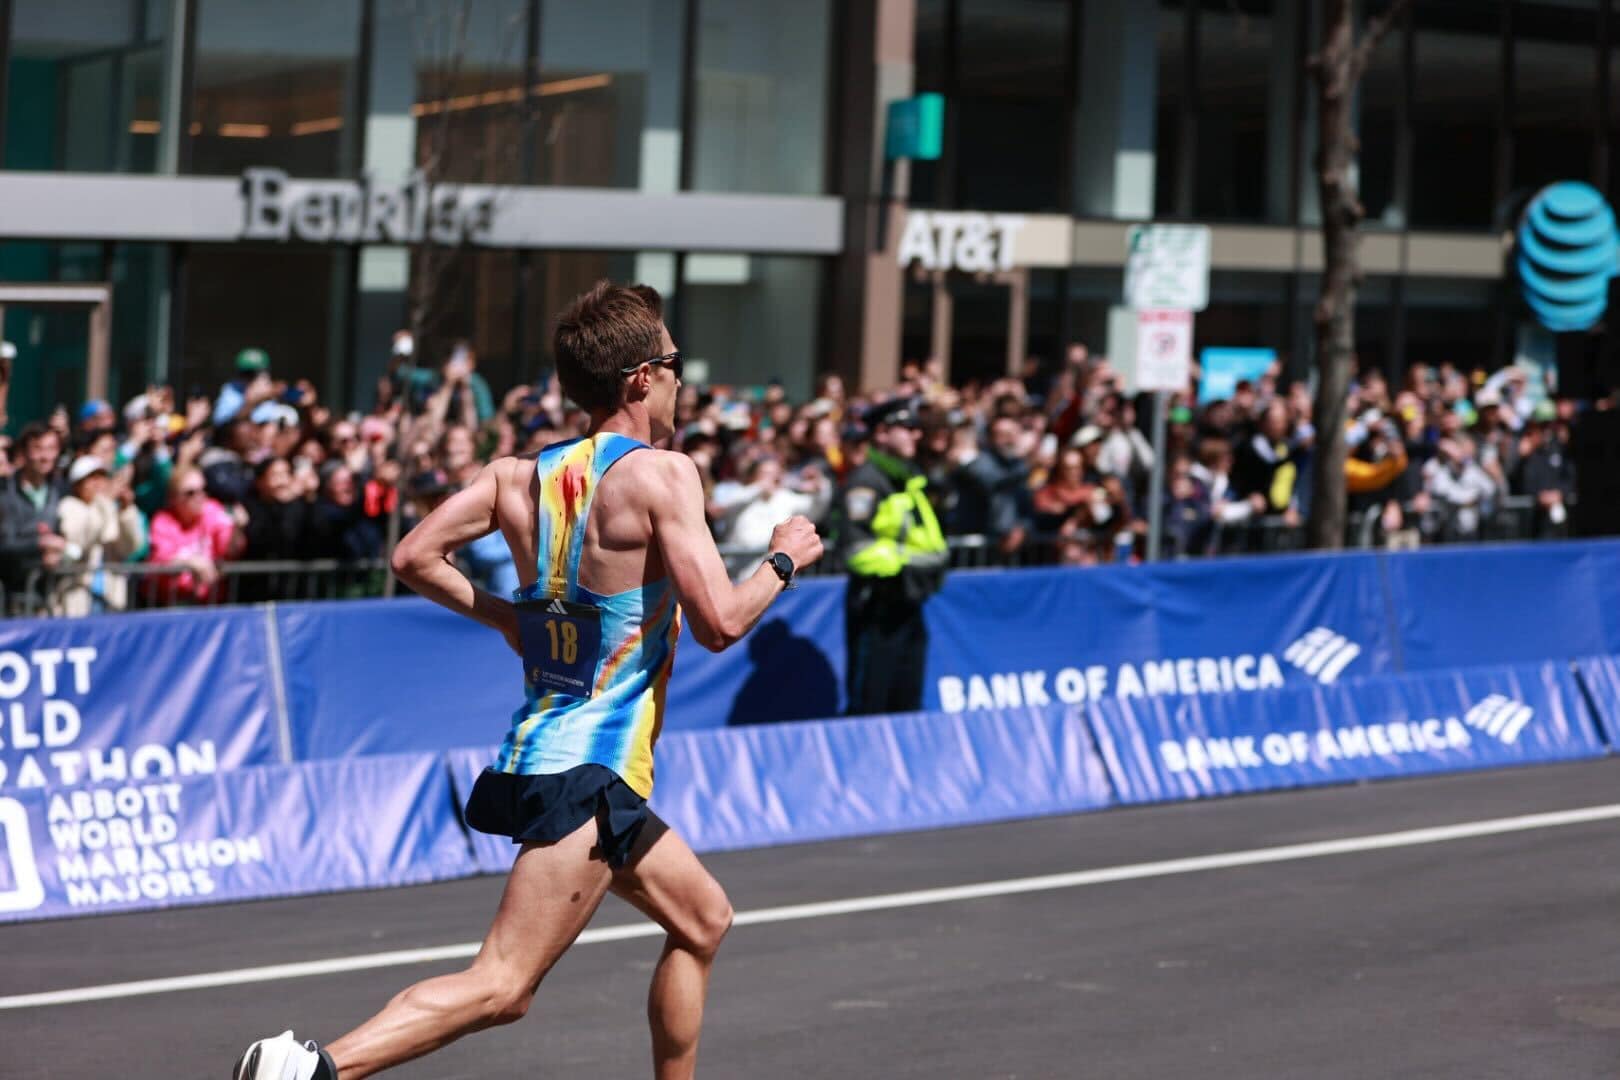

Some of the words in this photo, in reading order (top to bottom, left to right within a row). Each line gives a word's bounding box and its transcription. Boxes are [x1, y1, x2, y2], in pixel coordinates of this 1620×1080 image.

[898, 211, 1024, 272] AT&T
[545, 619, 578, 664] 18
[938, 670, 1050, 713] BANK
[1055, 666, 1107, 704] OF
[1116, 654, 1284, 700] AMERICA
[0, 700, 81, 749] LD
[1160, 736, 1263, 773] BANK
[1262, 731, 1308, 766] OF
[1315, 717, 1471, 760] AMERICA
[0, 740, 216, 789] ATHON
[48, 783, 182, 824] ABBOTT
[50, 813, 177, 852] WORLD
[57, 835, 263, 881] MARATHON
[66, 867, 215, 906] MAJORS
